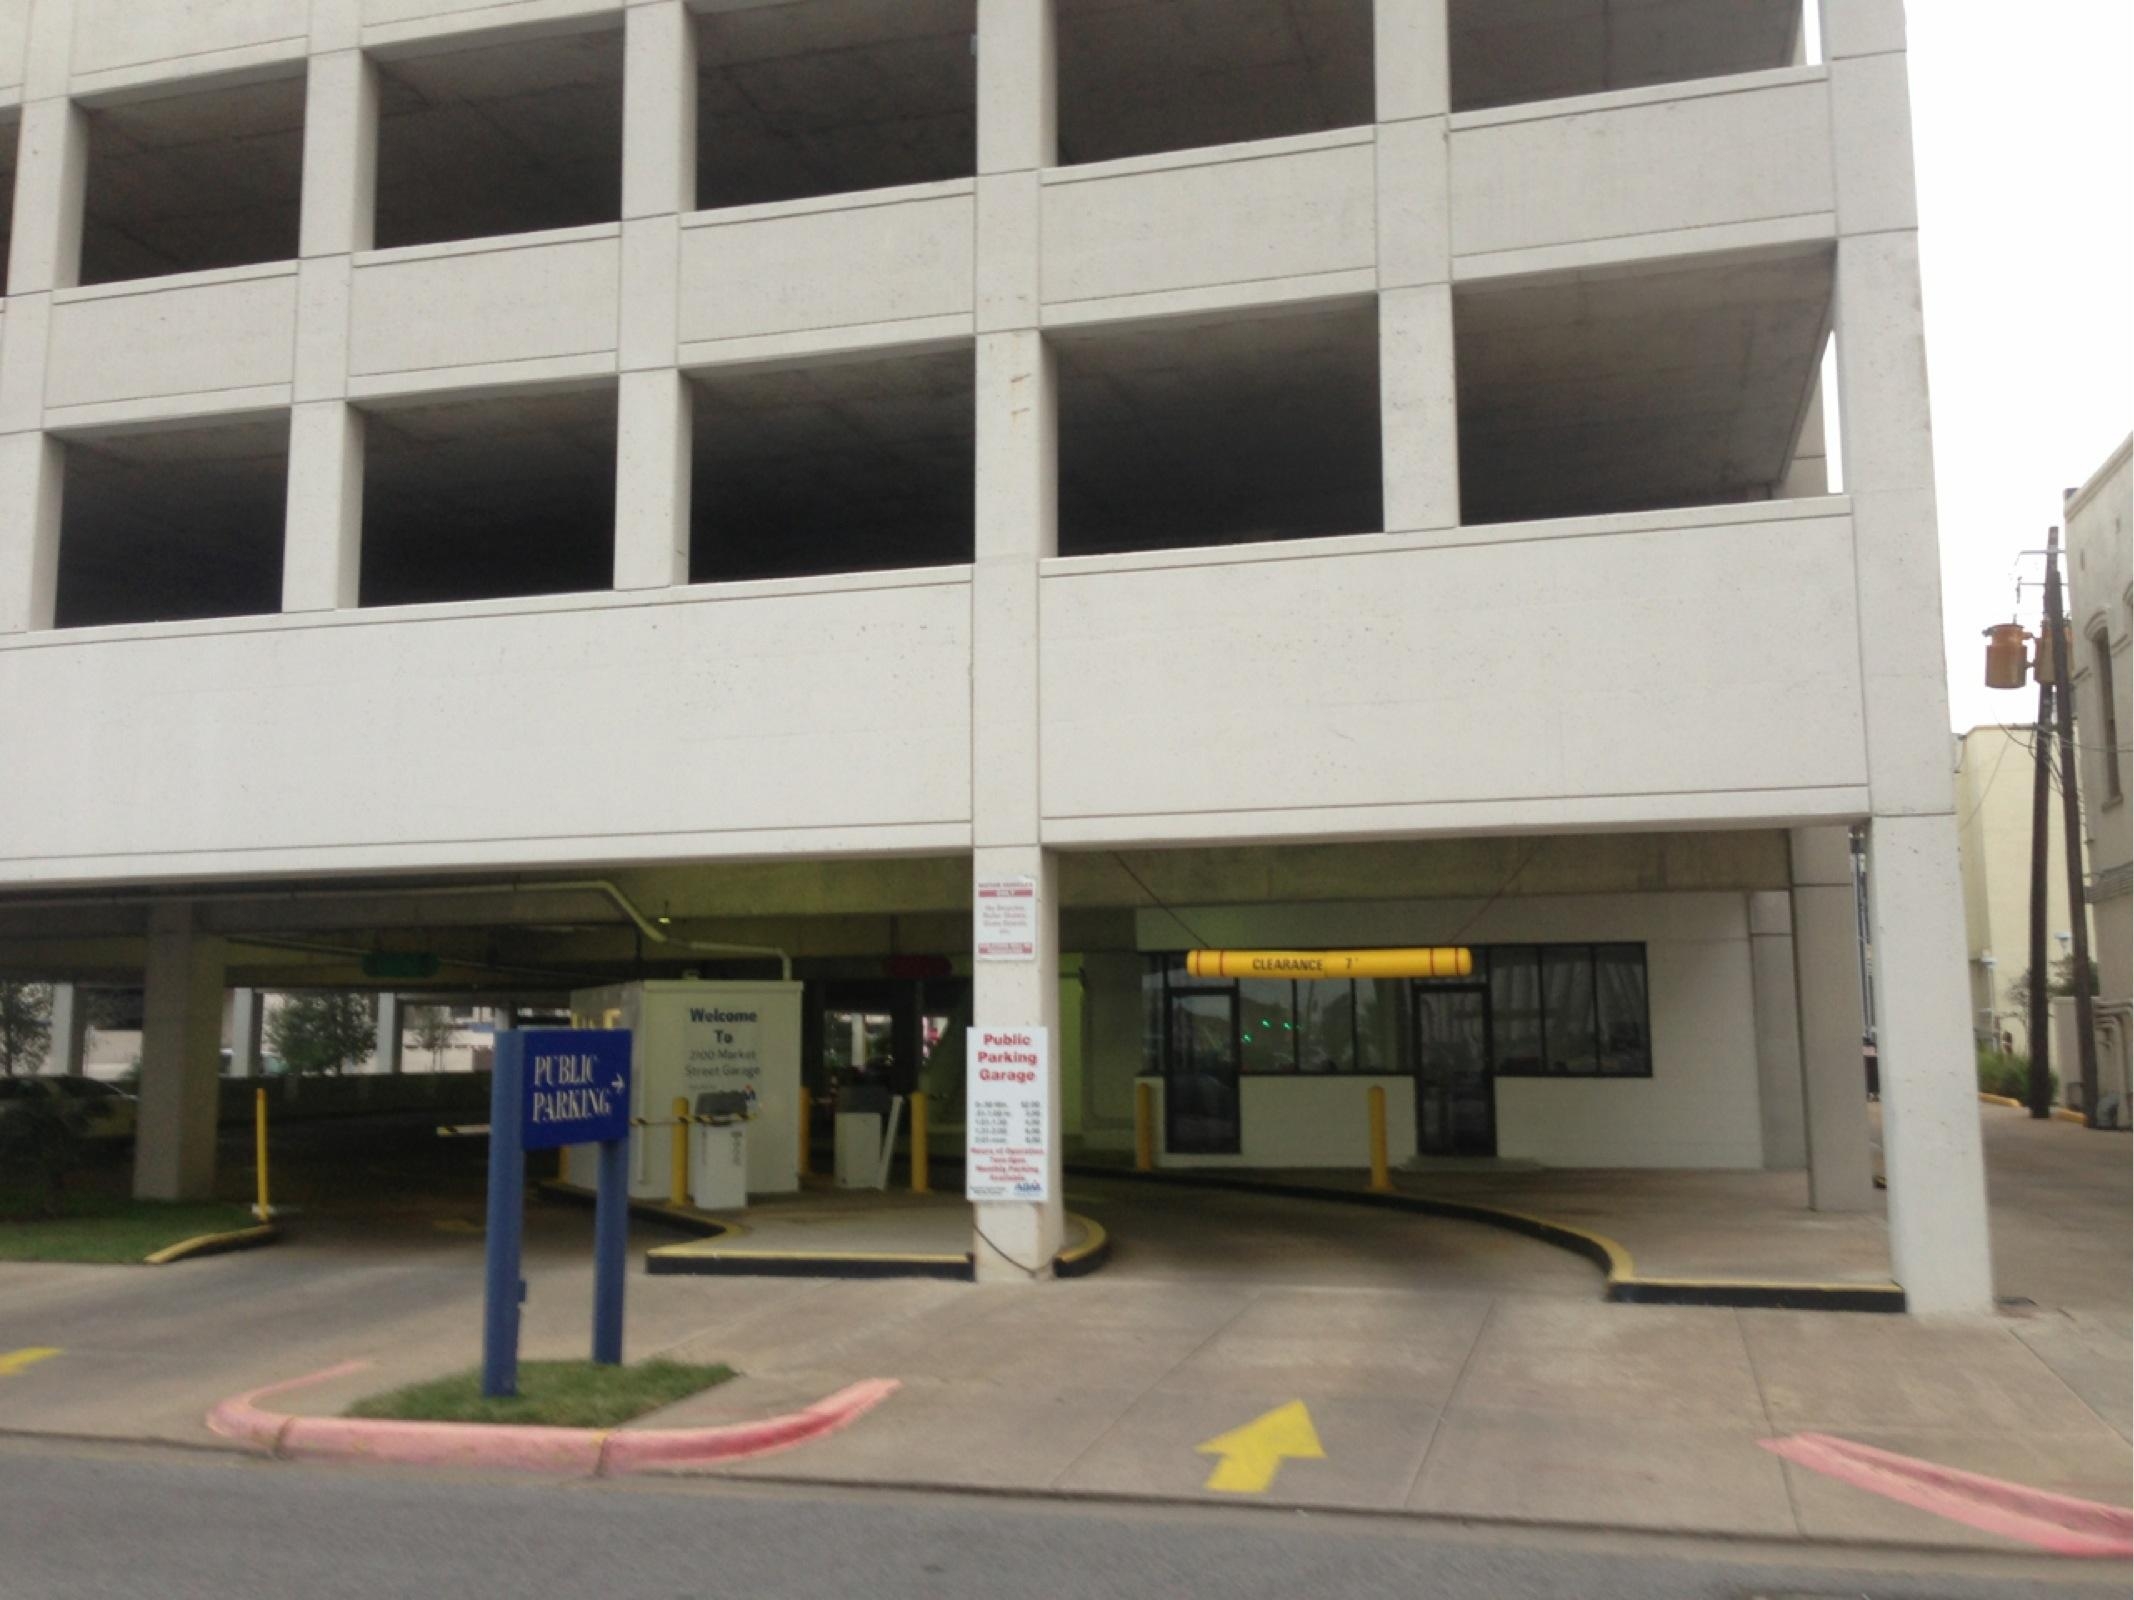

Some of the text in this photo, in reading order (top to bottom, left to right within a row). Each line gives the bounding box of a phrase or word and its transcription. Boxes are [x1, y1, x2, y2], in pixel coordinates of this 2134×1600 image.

[1253, 958, 1323, 971] CLEARANCE
[690, 1007, 757, 1022] Welcome
[714, 1029, 733, 1043] To
[983, 1033, 1032, 1046] Public
[718, 1049, 756, 1059] Market
[977, 1051, 1038, 1065] Parking
[534, 1054, 598, 1086] PUBLIC
[685, 1064, 760, 1079] Street Garage
[979, 1068, 1036, 1083] Garage
[532, 1087, 612, 1122] PARKING
